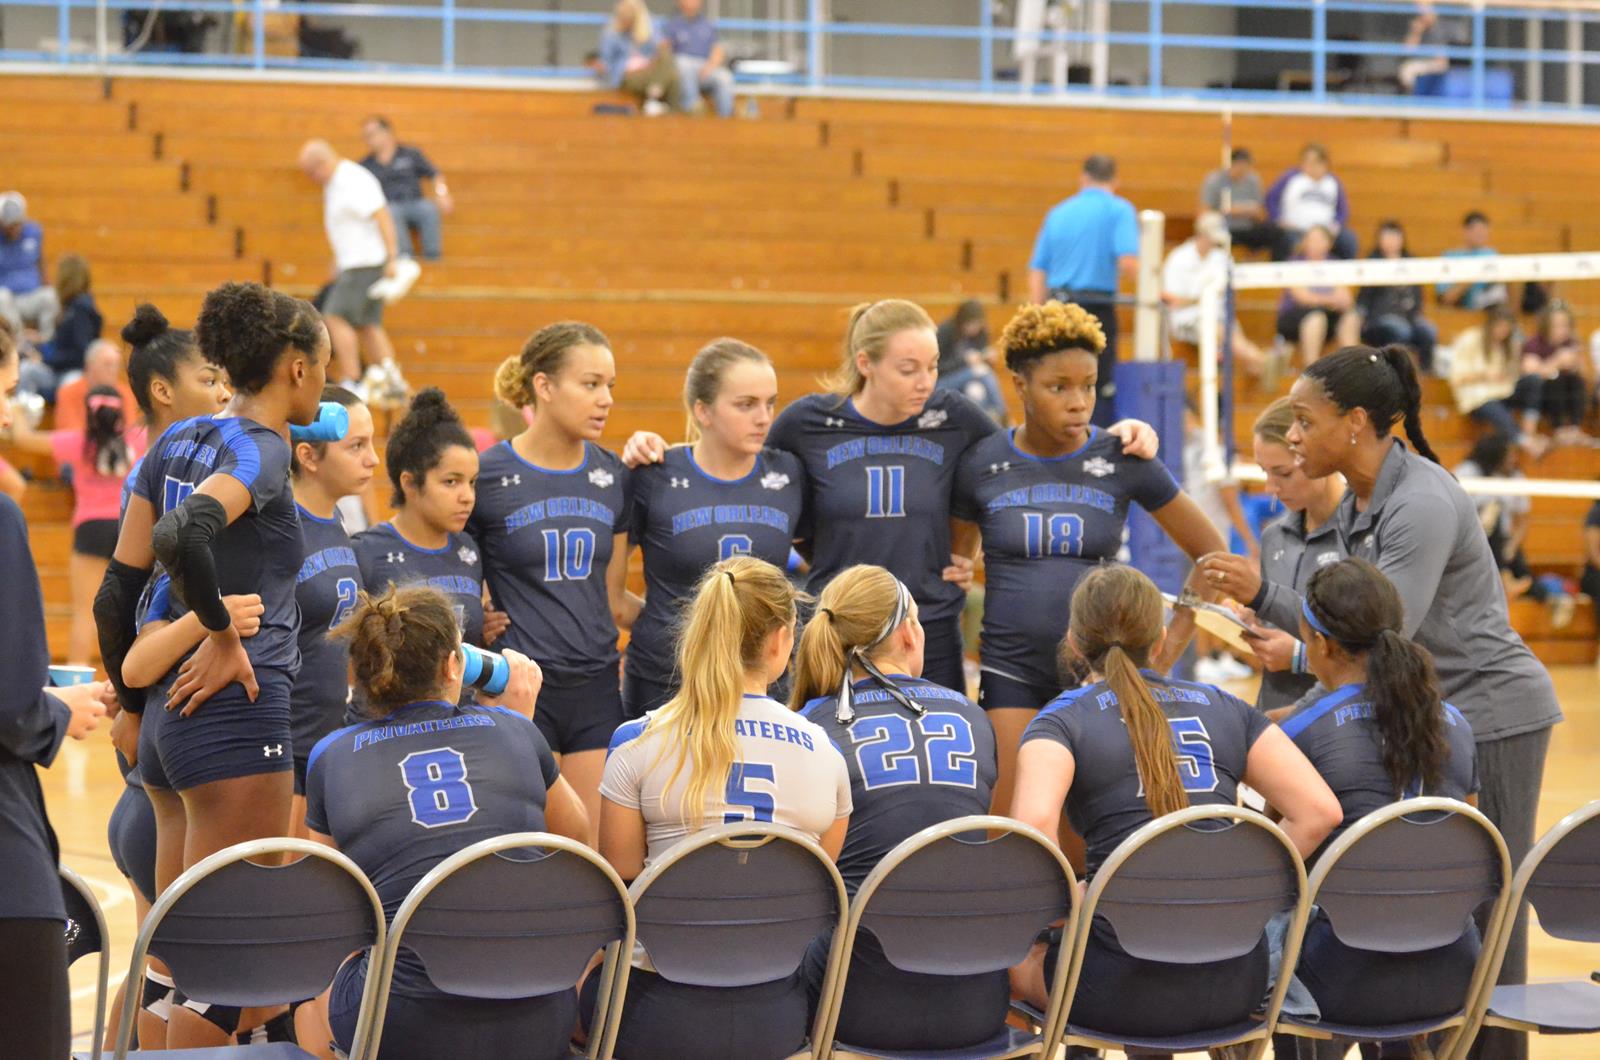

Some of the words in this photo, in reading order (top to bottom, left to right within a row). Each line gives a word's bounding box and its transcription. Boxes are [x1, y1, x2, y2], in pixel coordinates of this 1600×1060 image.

[826, 437, 866, 470] NEW
[866, 435, 944, 466] ORLEANS
[504, 501, 546, 535] NEW
[546, 496, 615, 530] ORLEANS
[865, 465, 906, 518] 11
[1031, 483, 1115, 514] ORLEANS
[672, 506, 714, 536] NEW
[714, 504, 789, 534] ORLEANS
[1022, 512, 1084, 560] 18
[541, 528, 596, 582] 10
[328, 577, 358, 631] 2
[352, 713, 497, 753] PRIVATEERS
[734, 718, 815, 753] ATEERS
[846, 711, 978, 791] 22
[397, 746, 479, 829] 8
[722, 761, 777, 825] 5
